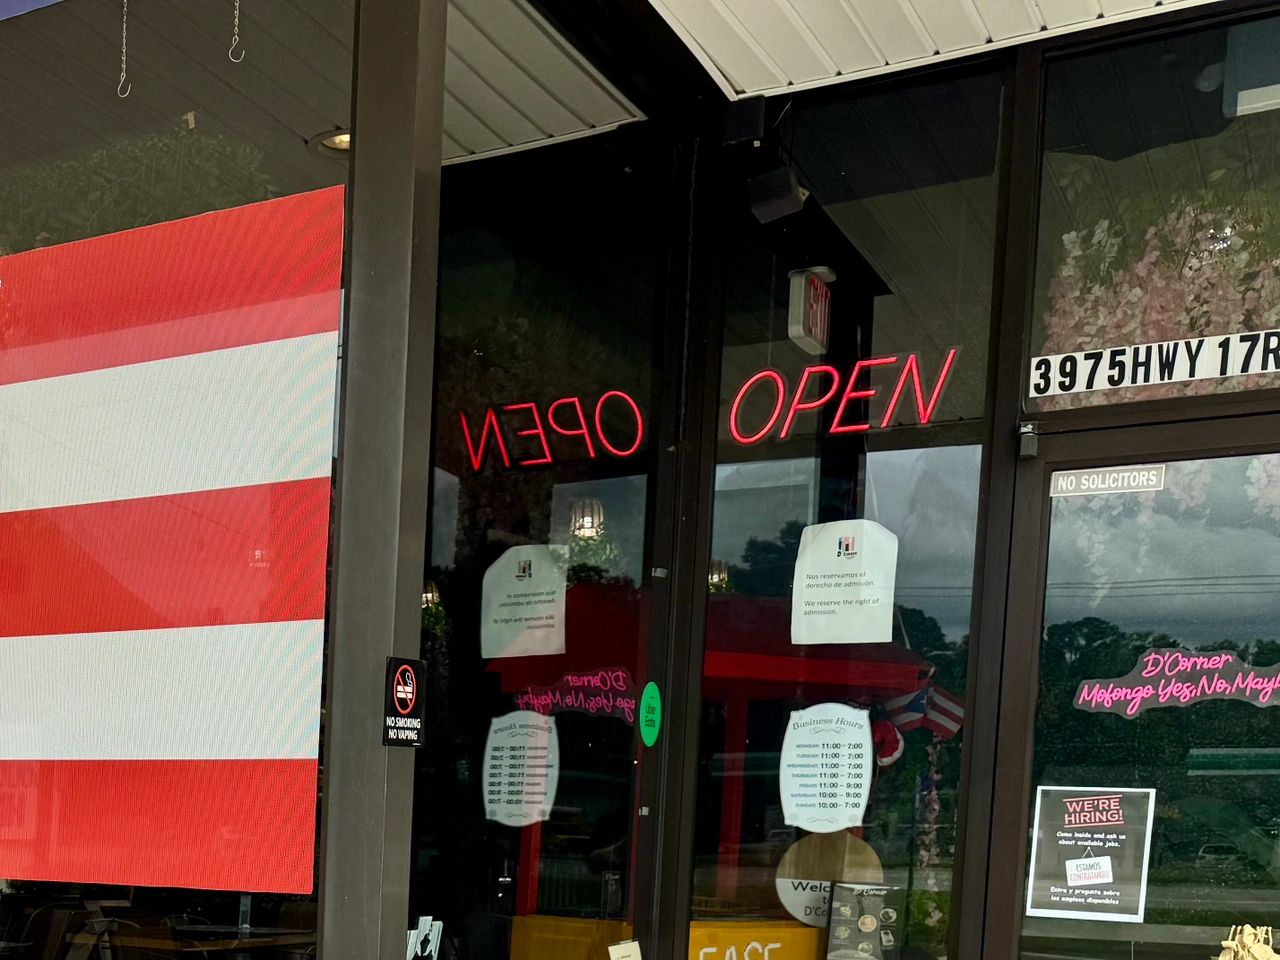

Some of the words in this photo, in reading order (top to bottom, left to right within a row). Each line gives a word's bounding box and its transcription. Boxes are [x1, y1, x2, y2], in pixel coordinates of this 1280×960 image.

[729, 348, 957, 445] OPEN
[1058, 475, 1076, 491] NO
[1080, 470, 1157, 490] SOLICITORS
[1142, 652, 1232, 678] D'Corner
[1078, 683, 1156, 715] Mofongo
[386, 716, 395, 727] NO
[396, 717, 421, 728] SMOKING
[792, 717, 833, 731] Business
[835, 717, 864, 729] Hours
[388, 729, 397, 739] NO
[398, 729, 418, 740] VAPING
[1066, 799, 1120, 812] WE'RE
[1065, 810, 1123, 824] HIRING!
[1076, 862, 1101, 872] ESTAMOS
[791, 881, 831, 893] Welc
